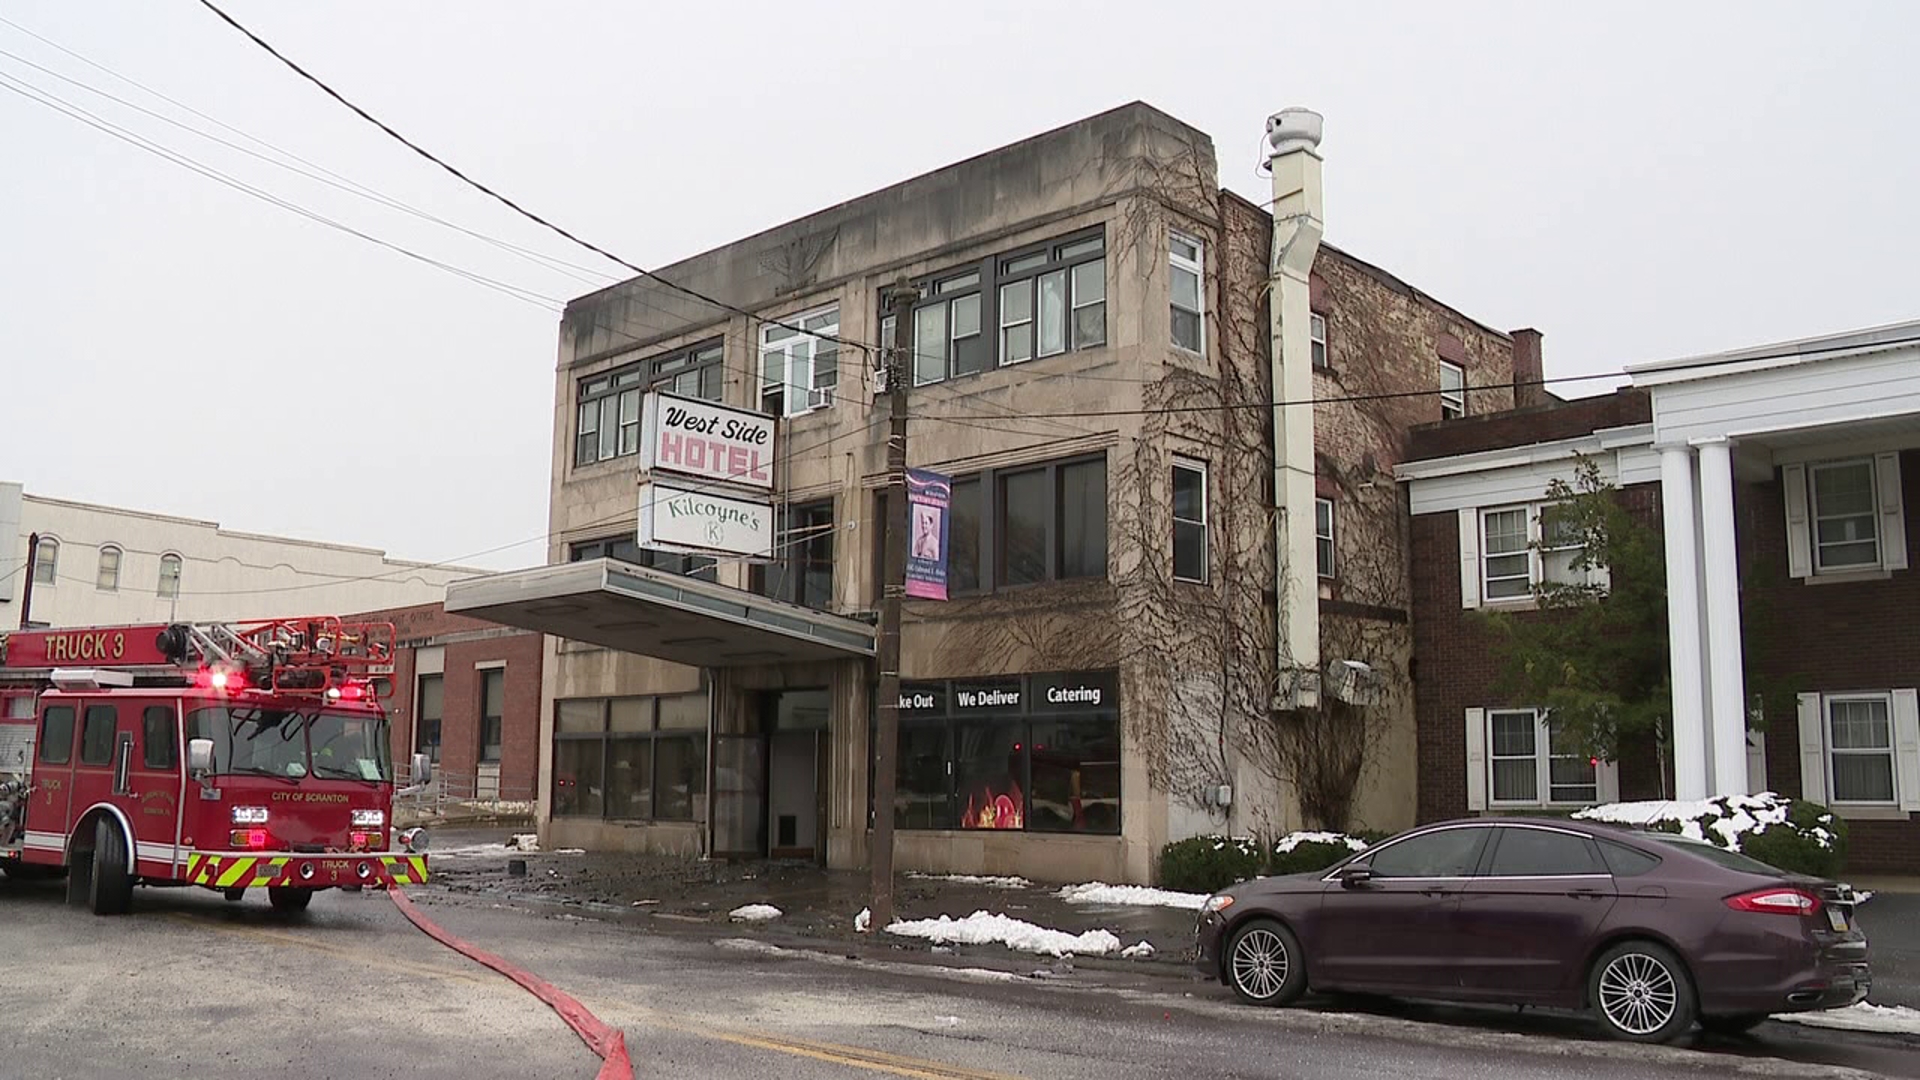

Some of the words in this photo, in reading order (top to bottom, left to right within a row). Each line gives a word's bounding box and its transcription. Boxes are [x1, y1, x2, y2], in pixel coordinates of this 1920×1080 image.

[665, 407, 720, 435] West
[721, 419, 768, 445] Side
[661, 431, 768, 481] HOTEL
[668, 497, 760, 532] Kilcoyne's
[45, 633, 108, 660] TRUCK
[113, 632, 125, 659] 3
[899, 694, 913, 709] ke
[913, 694, 934, 709] Out
[957, 692, 978, 707] We
[978, 690, 1020, 706] Deliver
[1047, 685, 1101, 704] Catering
[271, 792, 291, 801] CITY
[292, 793, 304, 802] OF
[305, 793, 349, 803] SCRANTON
[321, 860, 349, 869] TRUCK
[330, 870, 338, 881] 3
